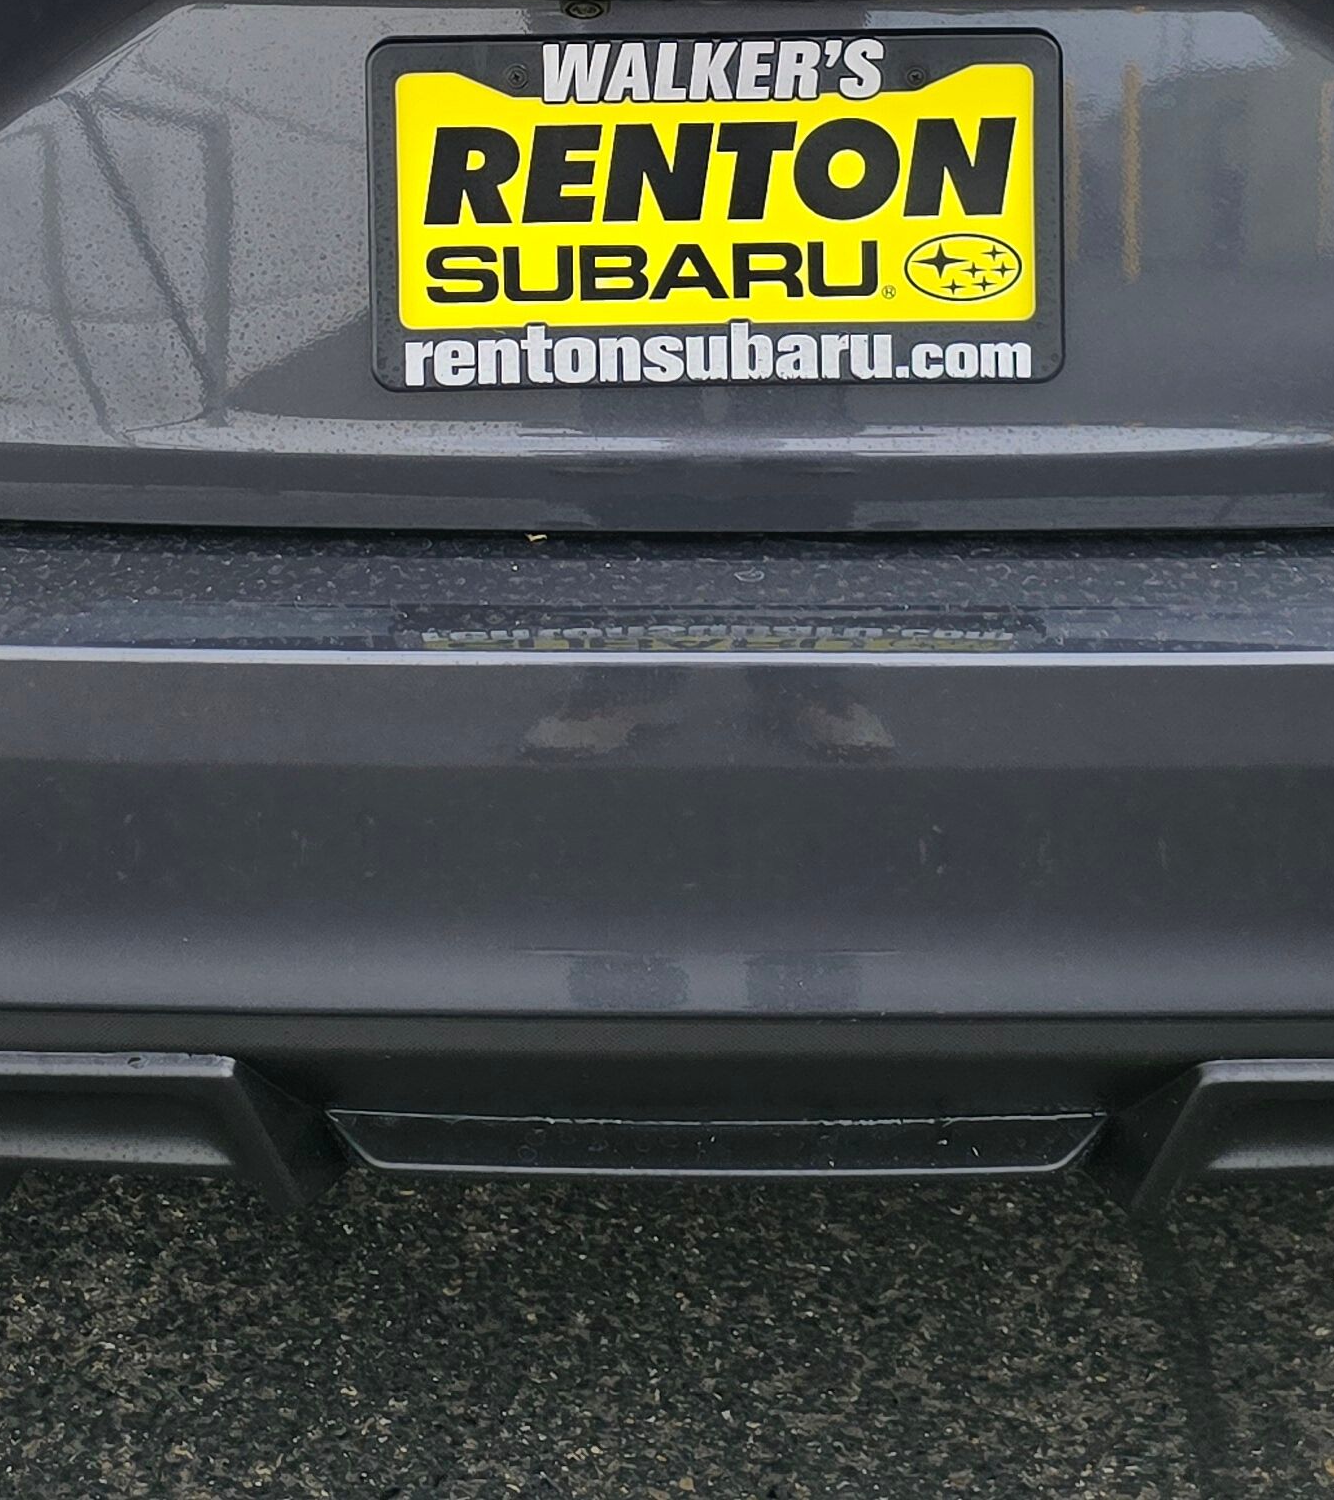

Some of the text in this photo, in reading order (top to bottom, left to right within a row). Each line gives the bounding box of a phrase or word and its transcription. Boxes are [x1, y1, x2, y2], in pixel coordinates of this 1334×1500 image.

[541, 38, 885, 103] WALKER'S
[423, 116, 1017, 225] RENTON
[425, 240, 879, 303] SUBARU
[404, 322, 1032, 387] rentonsubaru.com
